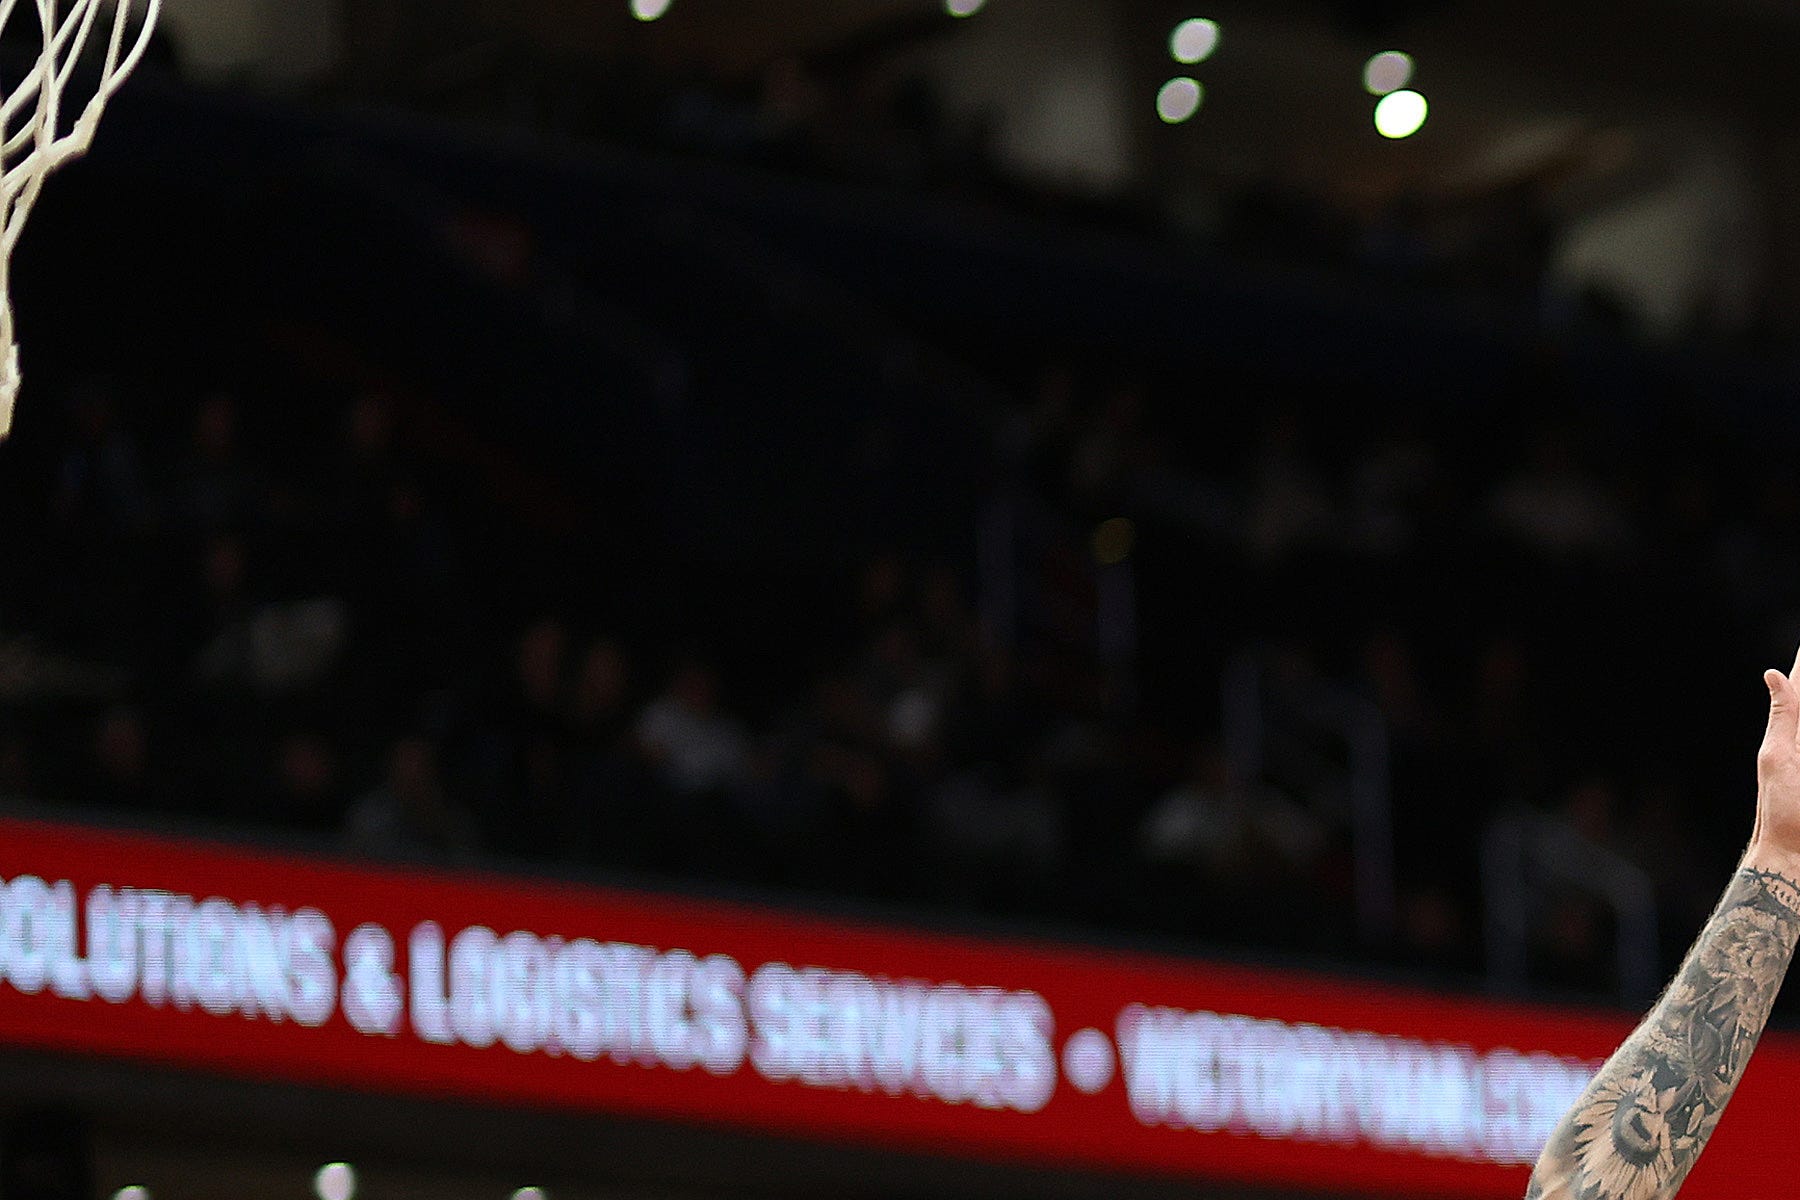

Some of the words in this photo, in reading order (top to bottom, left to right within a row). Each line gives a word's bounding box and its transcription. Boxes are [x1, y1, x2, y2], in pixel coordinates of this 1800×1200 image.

[0, 875, 335, 1027] OLUTIONS
[342, 922, 402, 1037] &
[409, 919, 748, 1076] LOGISTICS
[749, 961, 1056, 1113] SERVICES
